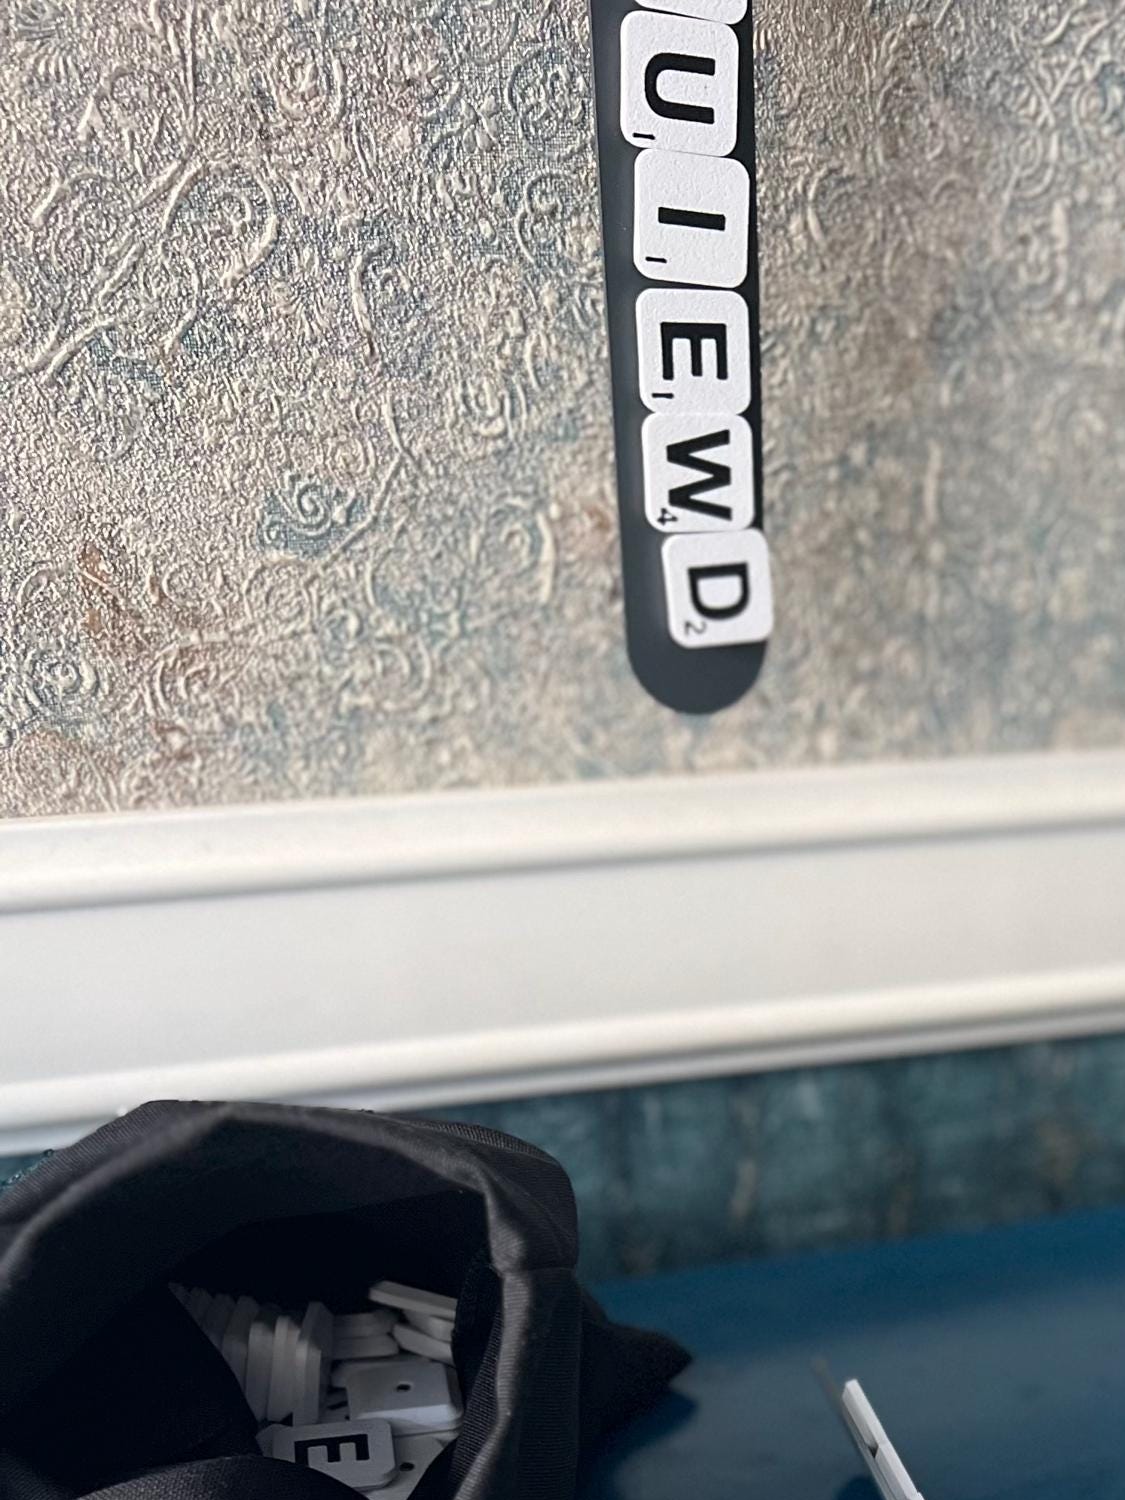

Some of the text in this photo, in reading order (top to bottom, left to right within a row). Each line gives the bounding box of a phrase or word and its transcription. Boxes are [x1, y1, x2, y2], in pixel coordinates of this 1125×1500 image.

[656, 507, 679, 526] 4
[684, 620, 708, 637] 2
[294, 1433, 370, 1466] E
